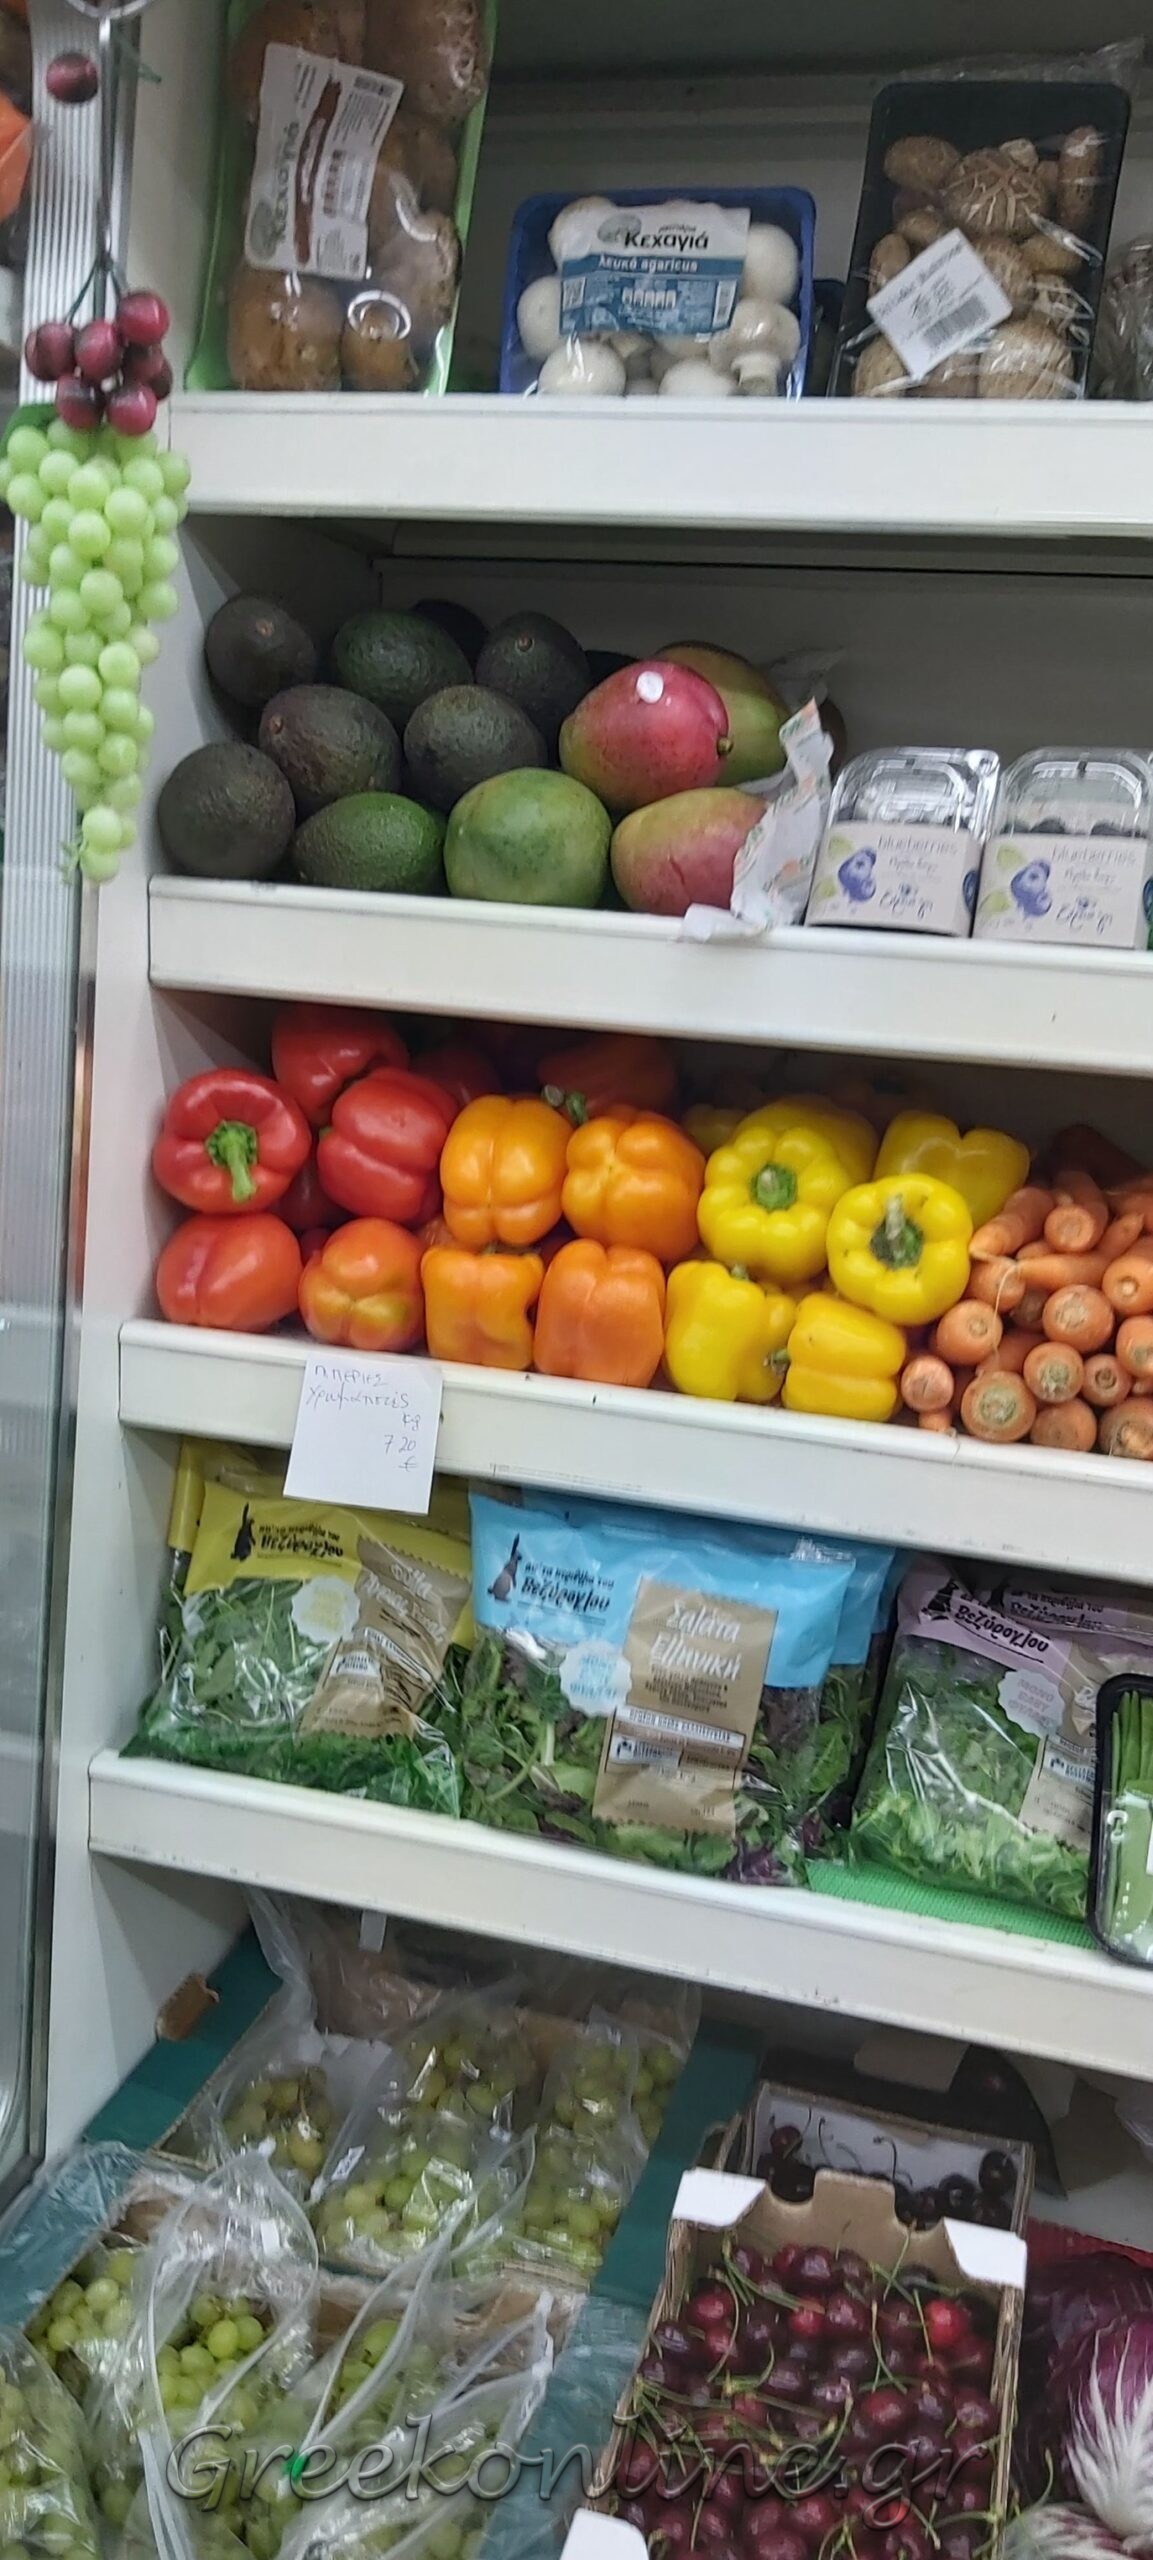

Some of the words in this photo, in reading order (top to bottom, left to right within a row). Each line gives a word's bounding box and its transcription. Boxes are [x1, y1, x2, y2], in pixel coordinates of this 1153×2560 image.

[624, 230, 710, 252] Κεχαγιά
[641, 258, 698, 274] agaricus
[954, 1604, 1050, 1652] Βεζύρογλου
